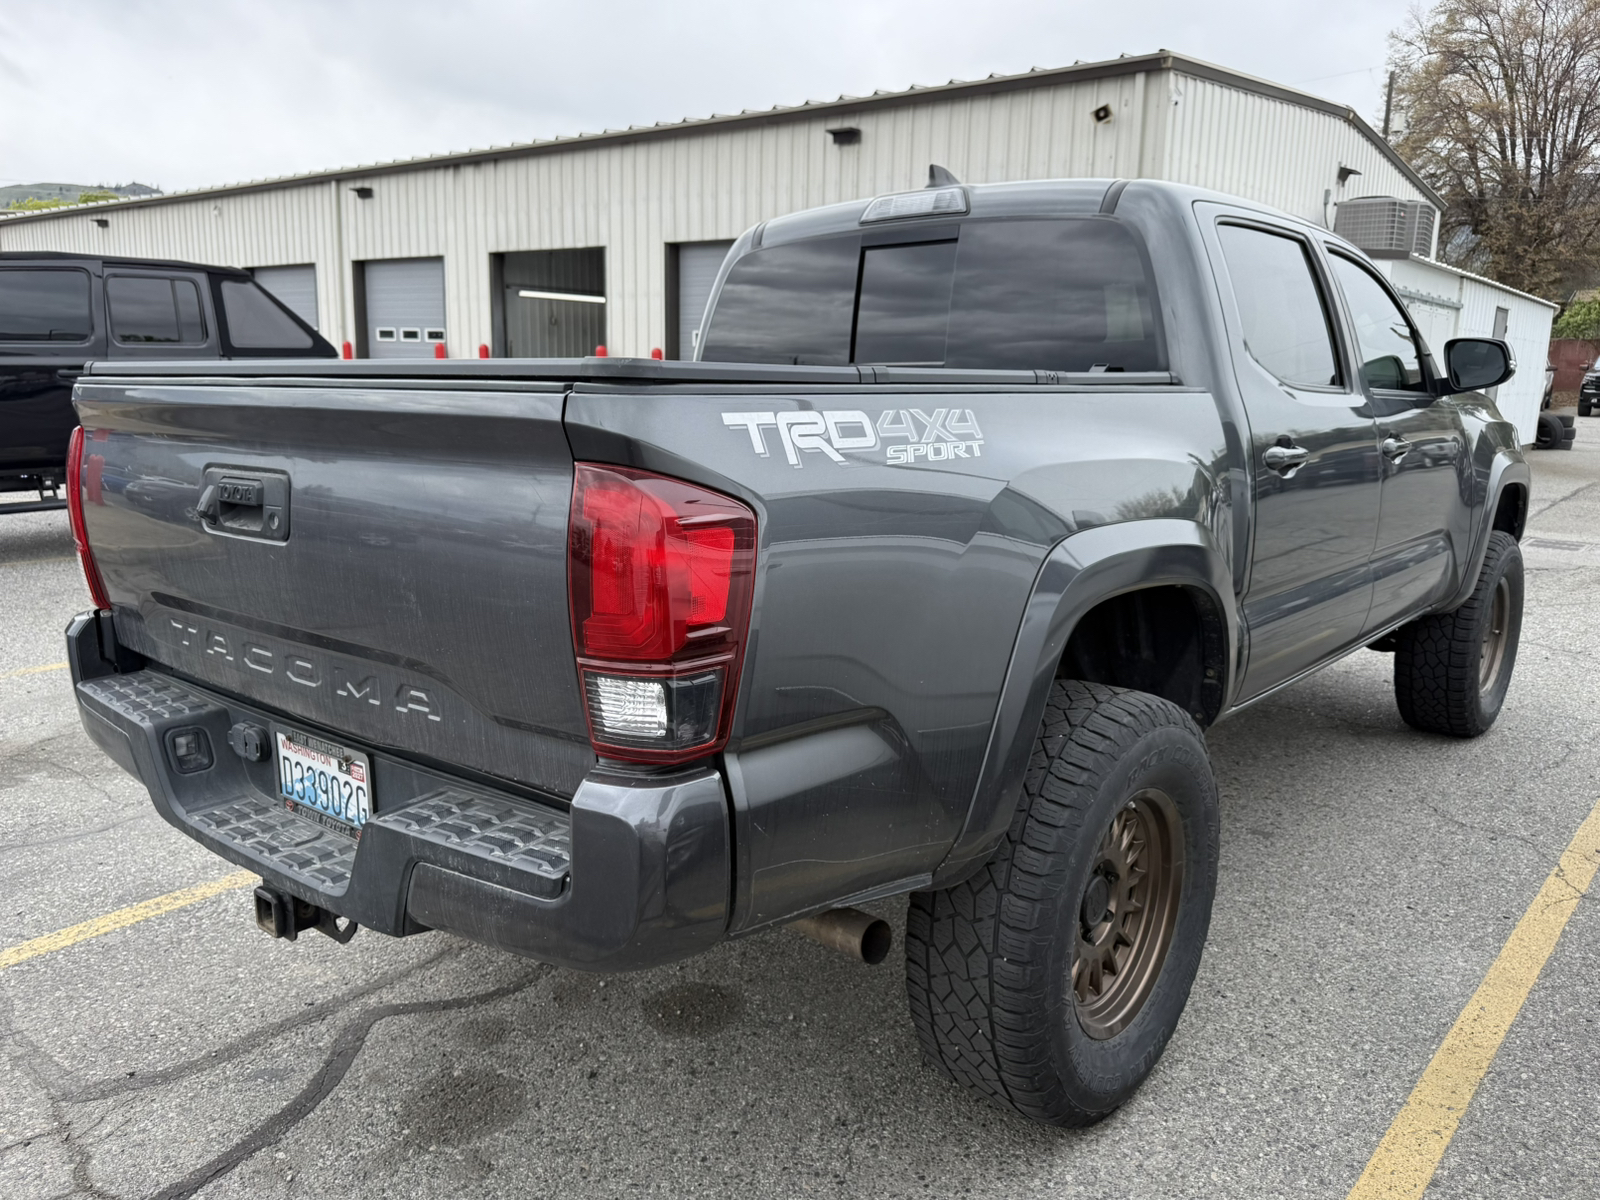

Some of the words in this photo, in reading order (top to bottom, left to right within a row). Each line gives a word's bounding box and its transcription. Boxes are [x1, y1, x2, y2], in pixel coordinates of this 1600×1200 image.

[721, 410, 881, 469] TRD
[876, 408, 985, 443] 4X4
[886, 440, 985, 465] SPORT
[218, 484, 255, 502] TOYOTA
[169, 618, 441, 722] TACOMA
[281, 738, 332, 767] WASHINGTON
[282, 755, 368, 827] D33902G
[297, 804, 321, 822] TOWN
[321, 815, 351, 837] TOYOTA
